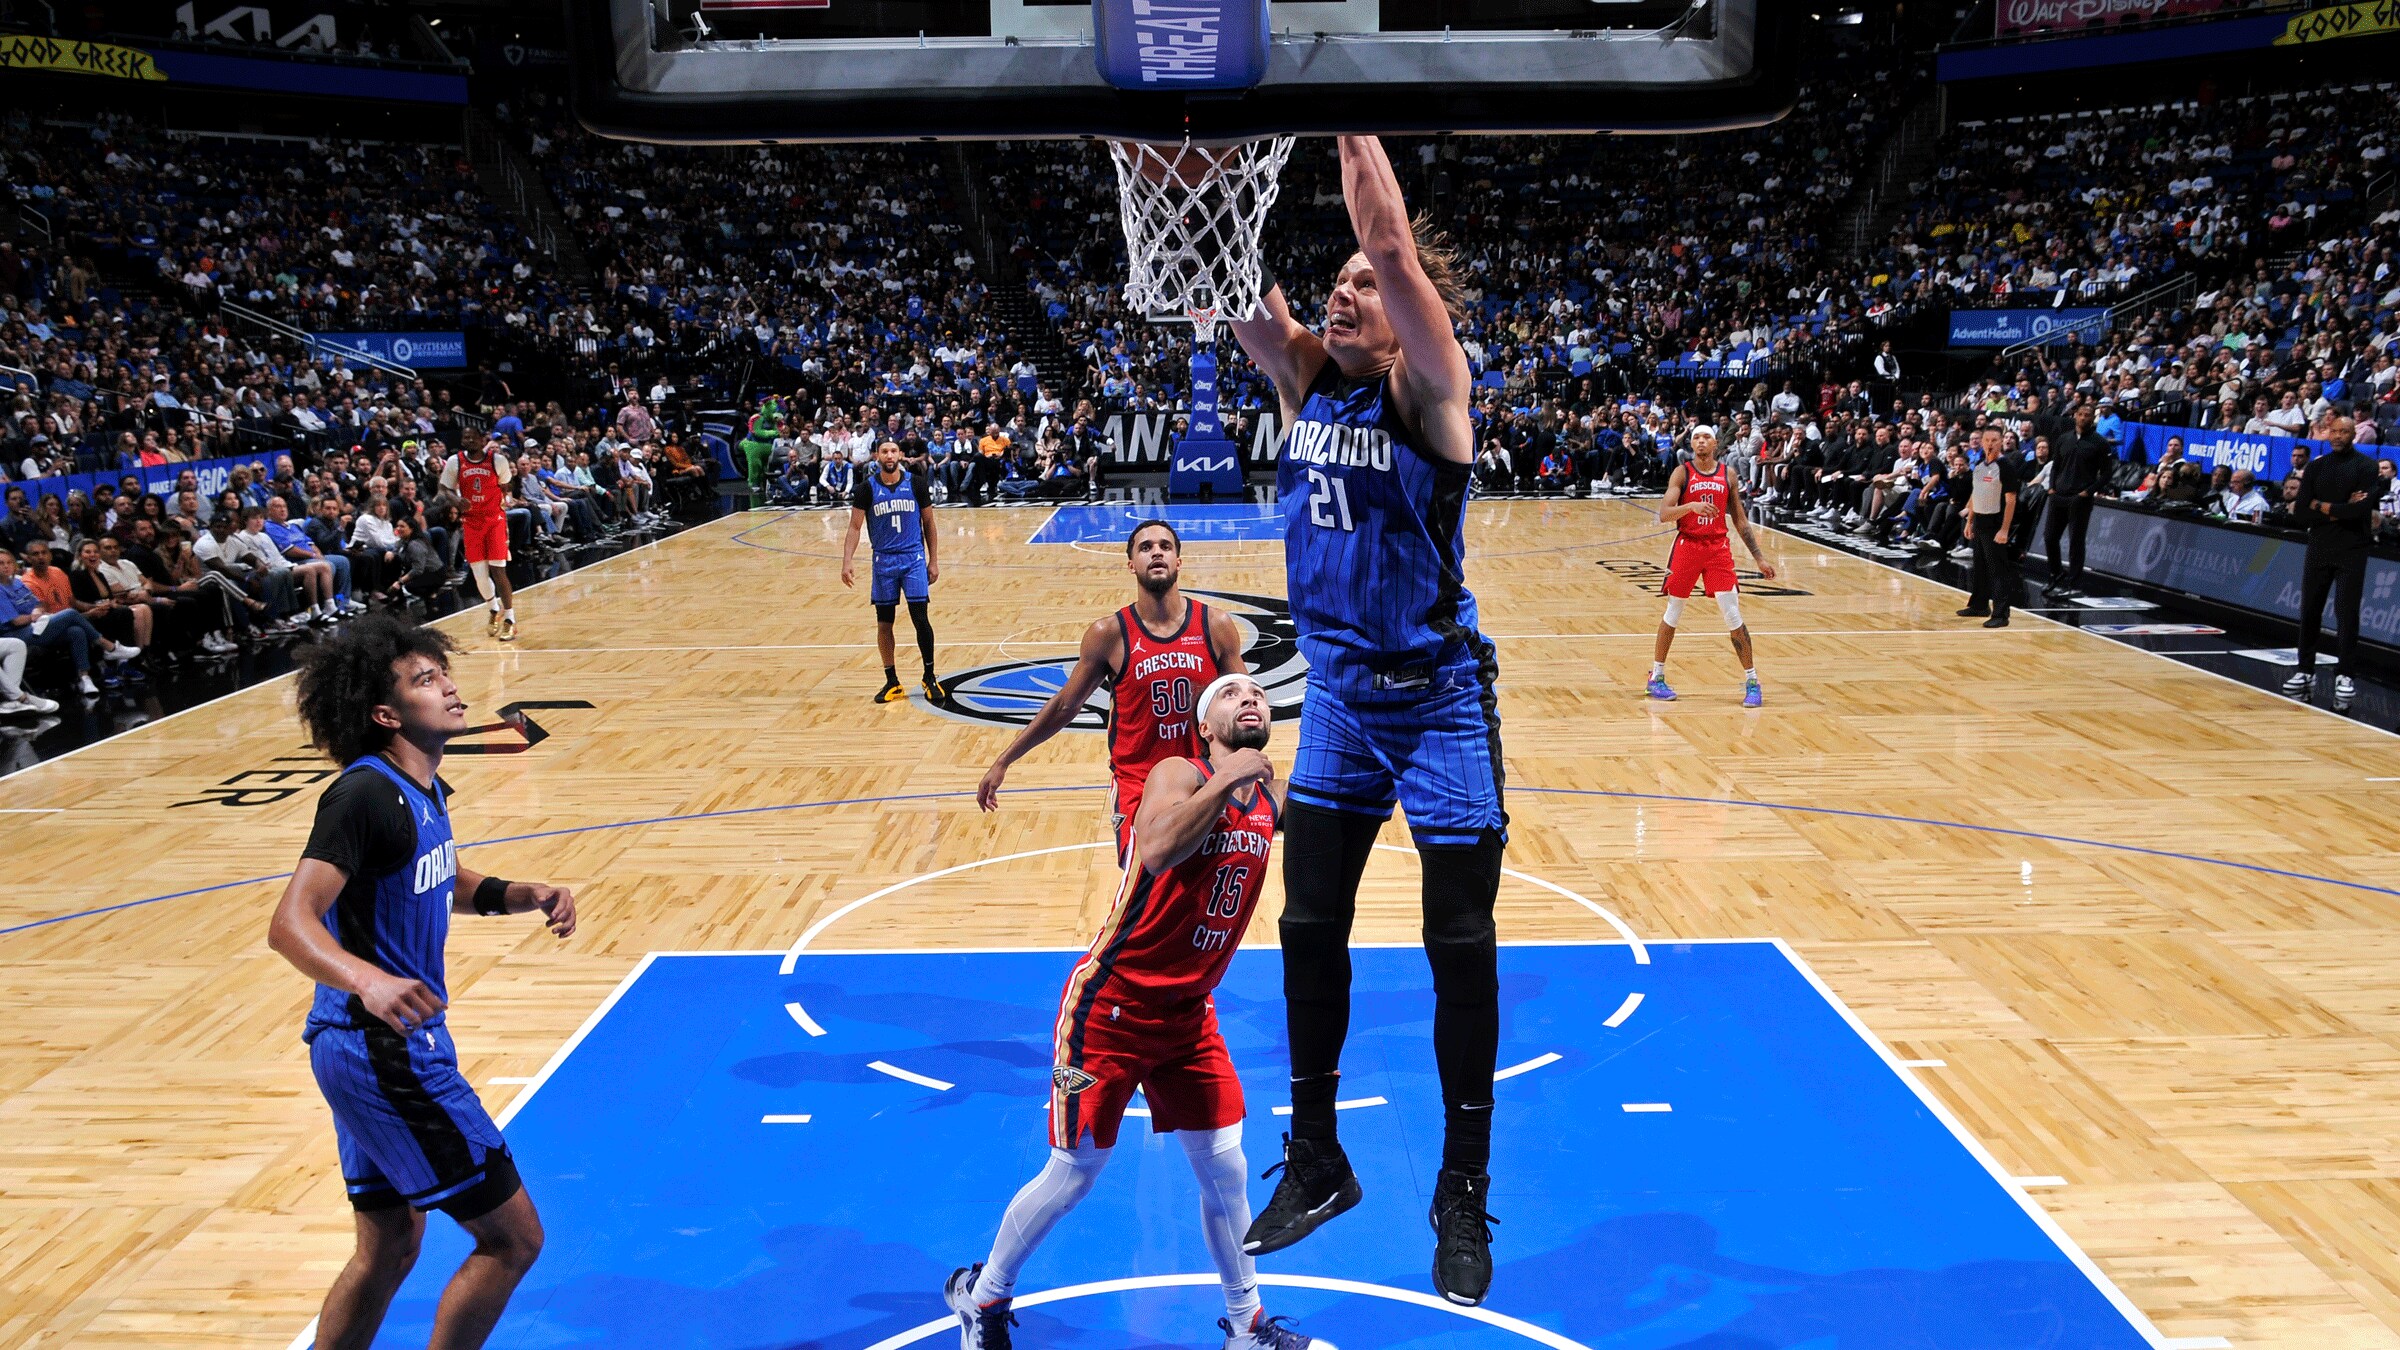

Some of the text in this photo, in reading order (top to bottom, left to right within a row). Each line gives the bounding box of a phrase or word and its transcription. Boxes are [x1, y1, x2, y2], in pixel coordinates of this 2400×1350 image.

[2295, 5, 2362, 42] GOOD
[1132, 0, 1221, 82] THREAT
[73, 40, 147, 79] GREEK
[1952, 327, 2022, 339] AdventHealth
[1289, 420, 1391, 472] ORLNDO
[1177, 456, 1235, 472] KIA
[473, 477, 481, 493] 4
[1689, 481, 1725, 493] CRESCENT
[873, 499, 915, 516] ORLANDO
[1308, 467, 1354, 531] 21
[891, 515, 902, 533] 4
[1135, 652, 1204, 680] CRESCENT
[1152, 677, 1192, 717] 50
[1158, 720, 1189, 740] CITY
[1206, 864, 1249, 918] 15
[1192, 924, 1232, 951] CITY
